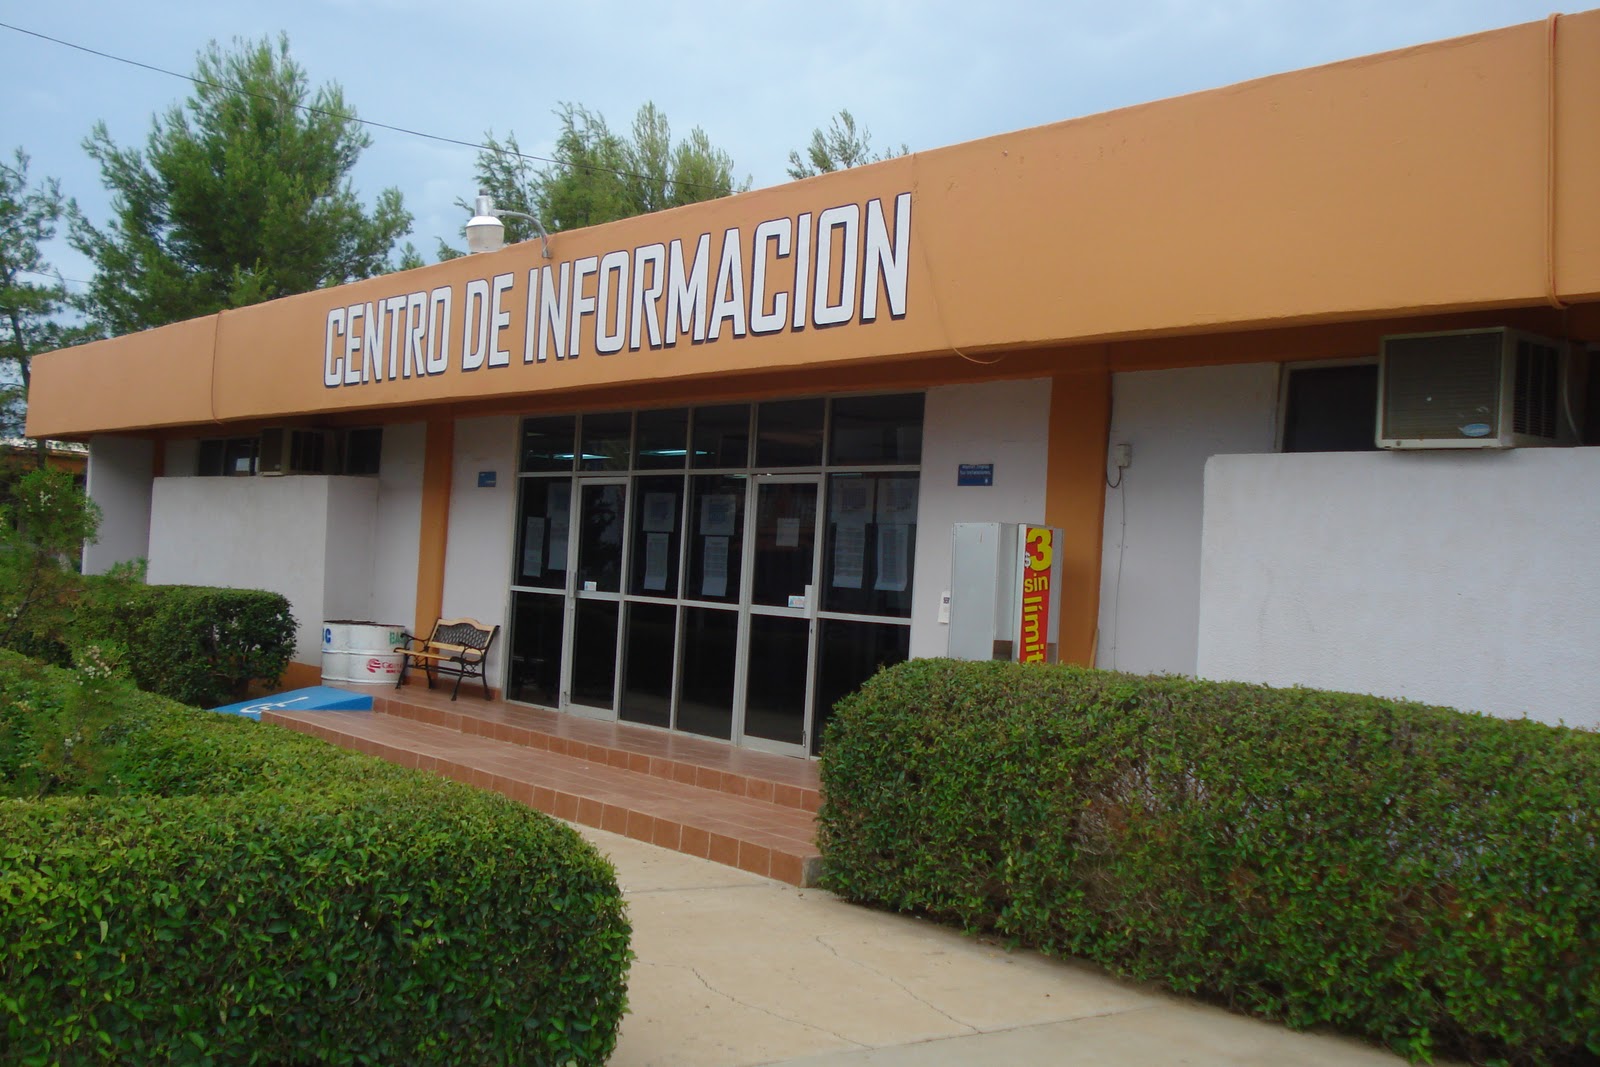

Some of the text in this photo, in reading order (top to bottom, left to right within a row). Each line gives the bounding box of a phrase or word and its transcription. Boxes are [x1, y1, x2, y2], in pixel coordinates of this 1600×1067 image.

[324, 192, 912, 387] CENTRO DE INFORMACION
[1024, 573, 1049, 593] sin
